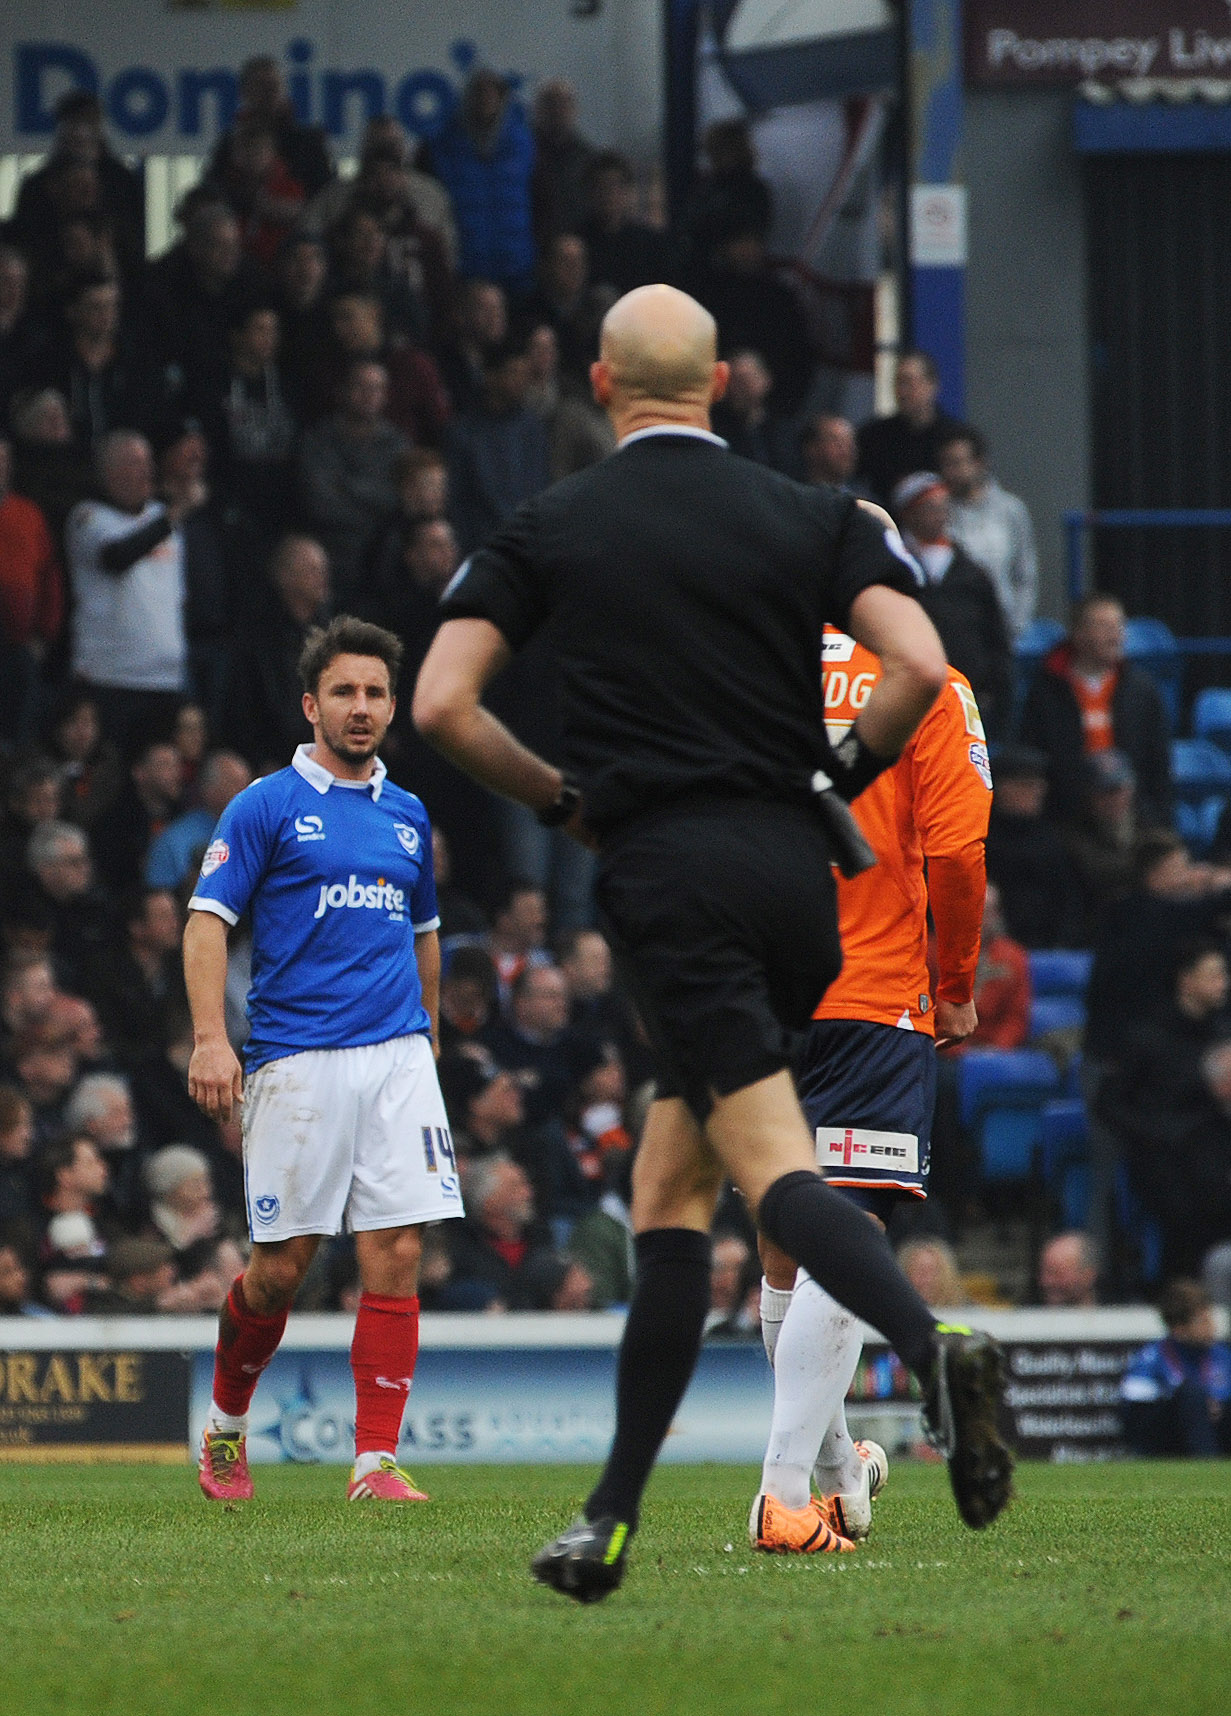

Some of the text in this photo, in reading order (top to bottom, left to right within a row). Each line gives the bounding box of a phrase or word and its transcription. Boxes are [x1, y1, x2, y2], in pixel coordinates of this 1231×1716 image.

[987, 28, 1159, 76] Pompey
[14, 40, 528, 137] Domino'
[822, 671, 876, 709] DG
[314, 874, 404, 919] jobsite
[421, 1126, 457, 1172] 14
[285, 1410, 476, 1456] COASS
